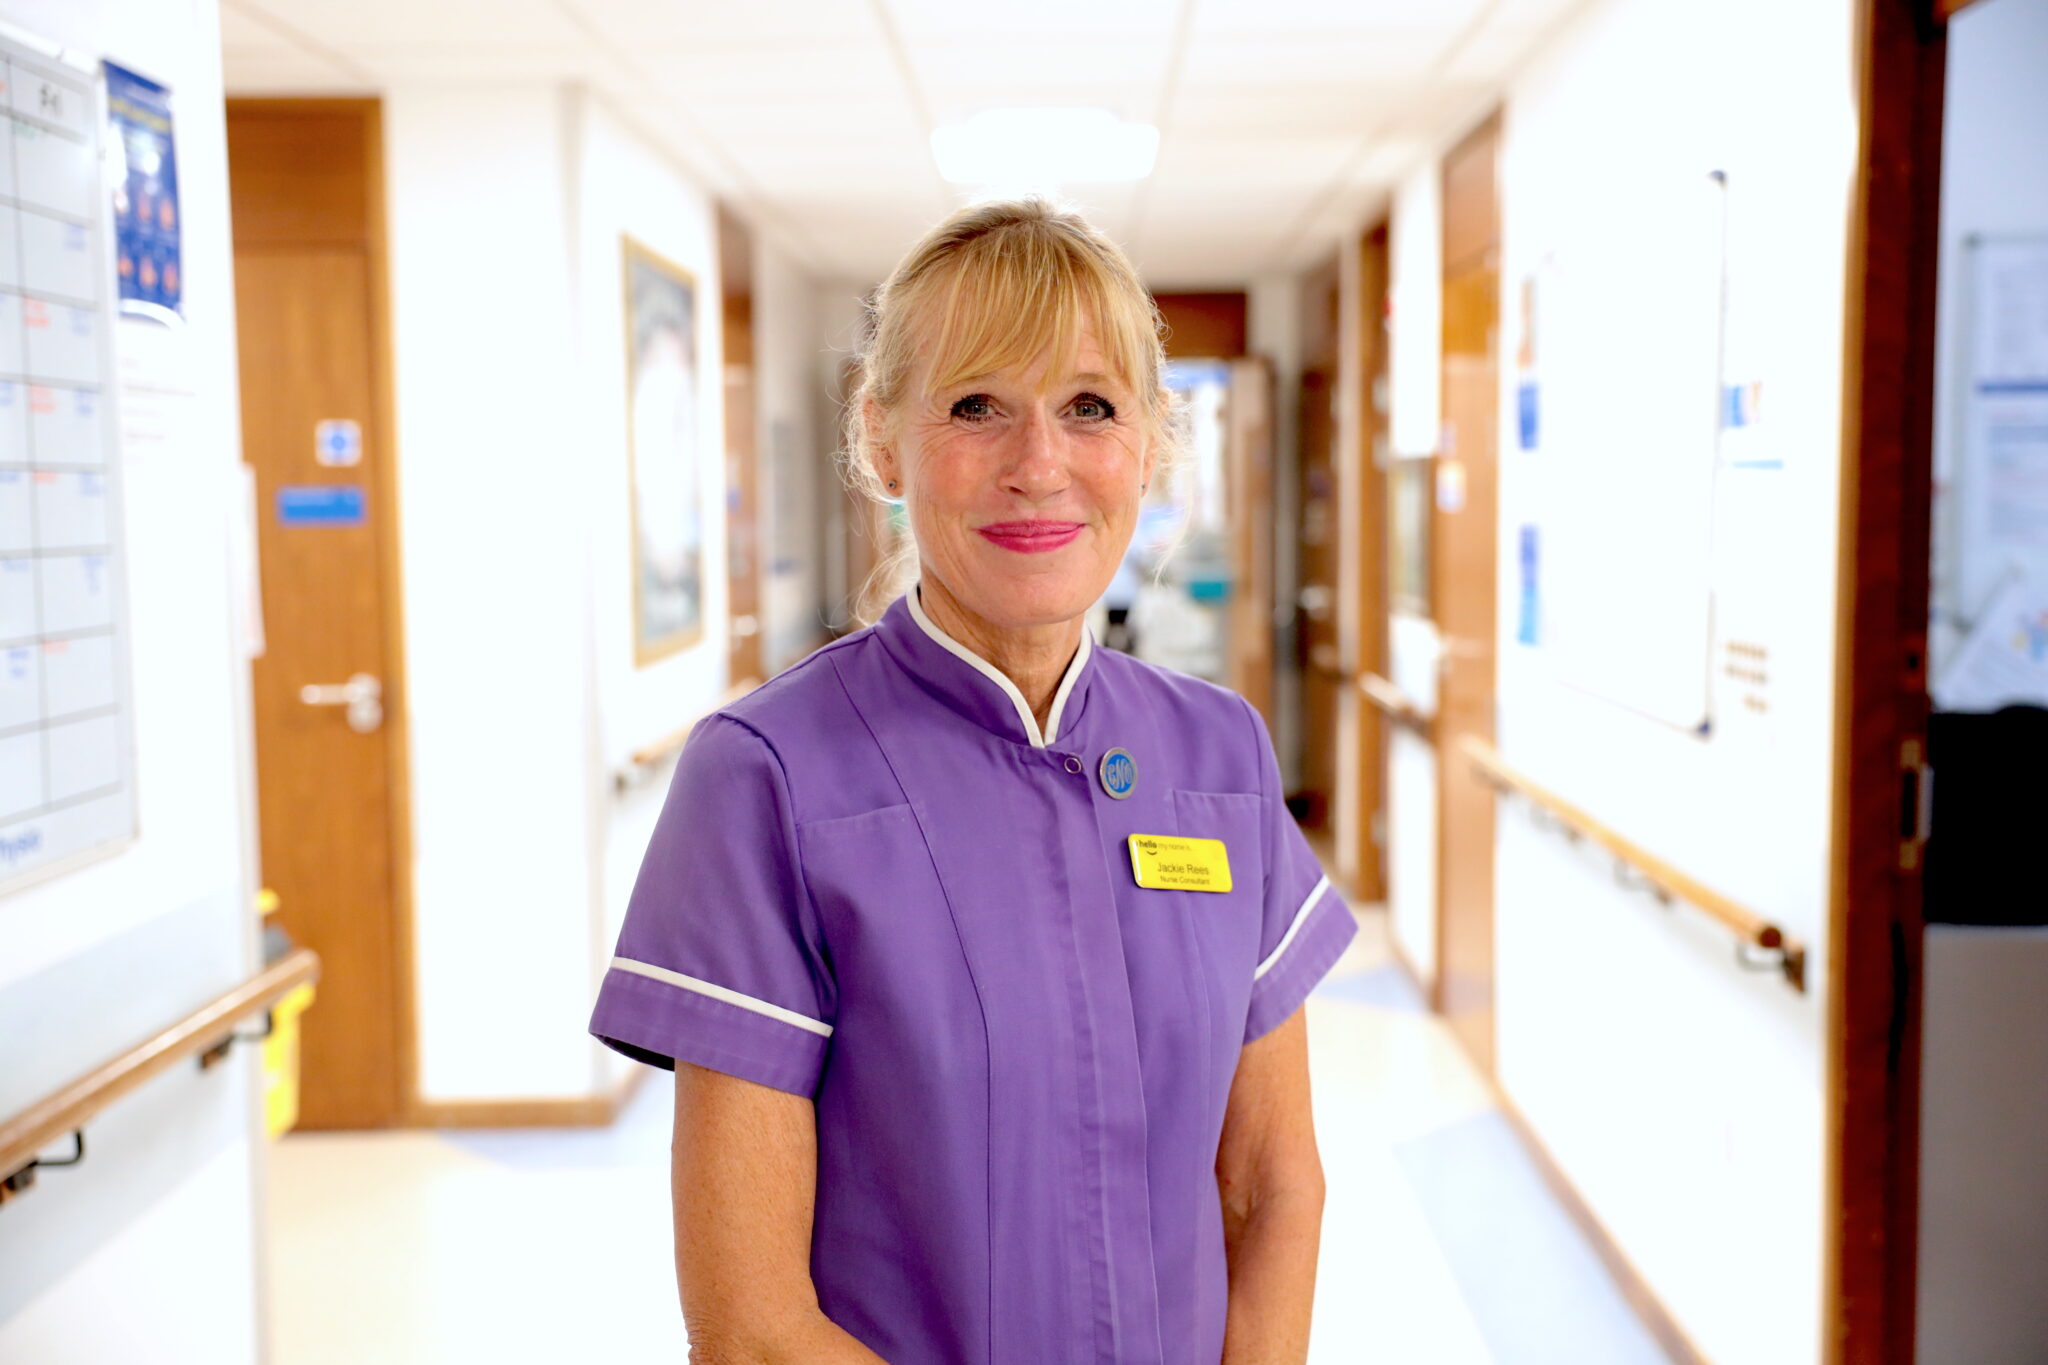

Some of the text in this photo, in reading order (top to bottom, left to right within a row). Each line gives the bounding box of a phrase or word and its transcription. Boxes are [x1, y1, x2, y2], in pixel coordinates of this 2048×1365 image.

[1139, 840, 1158, 849] hello
[1158, 863, 1210, 875] Jackie Rees
[1179, 876, 1210, 885] Consultant
